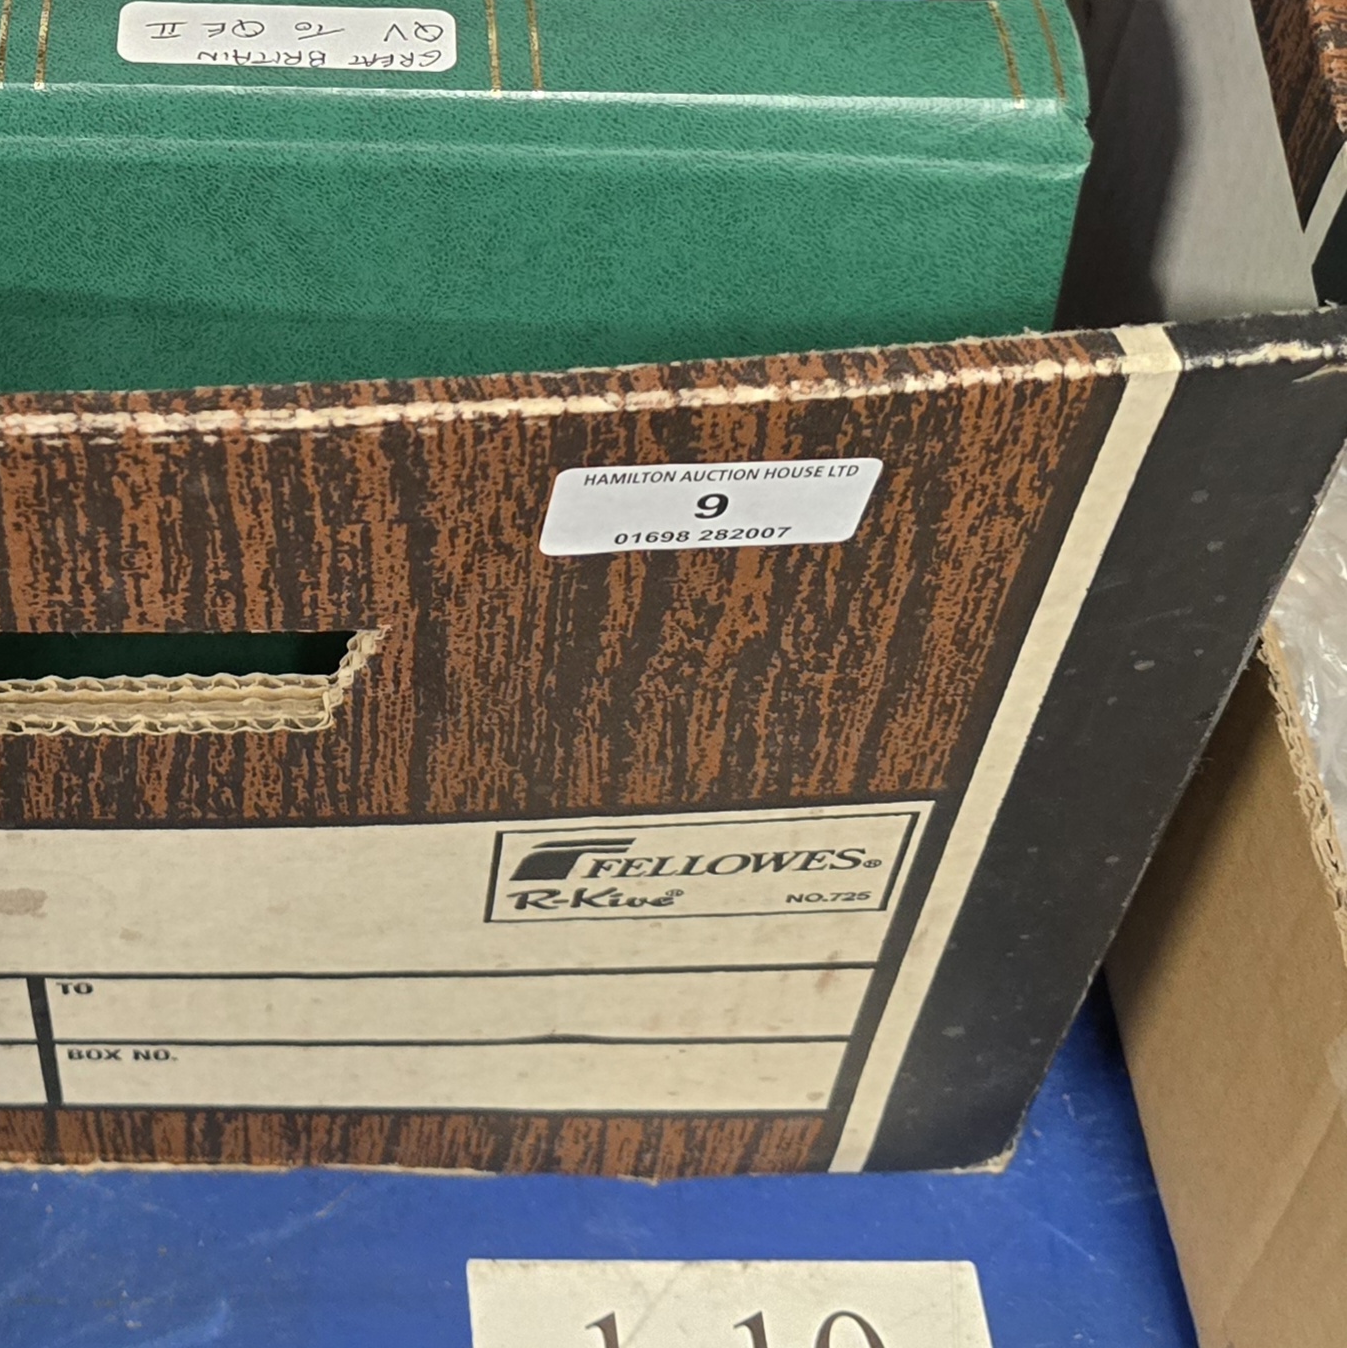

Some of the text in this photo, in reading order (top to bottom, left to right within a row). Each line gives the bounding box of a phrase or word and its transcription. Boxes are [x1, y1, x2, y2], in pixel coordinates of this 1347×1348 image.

[196, 48, 443, 69] GREAT BRITAIN
[583, 462, 860, 487] HAMILTON AUCTION HOUSE LTD
[694, 492, 730, 520] 9
[613, 525, 792, 547] 01698 282007
[56, 981, 94, 996] TO
[66, 1047, 179, 1063] BOX NO.
